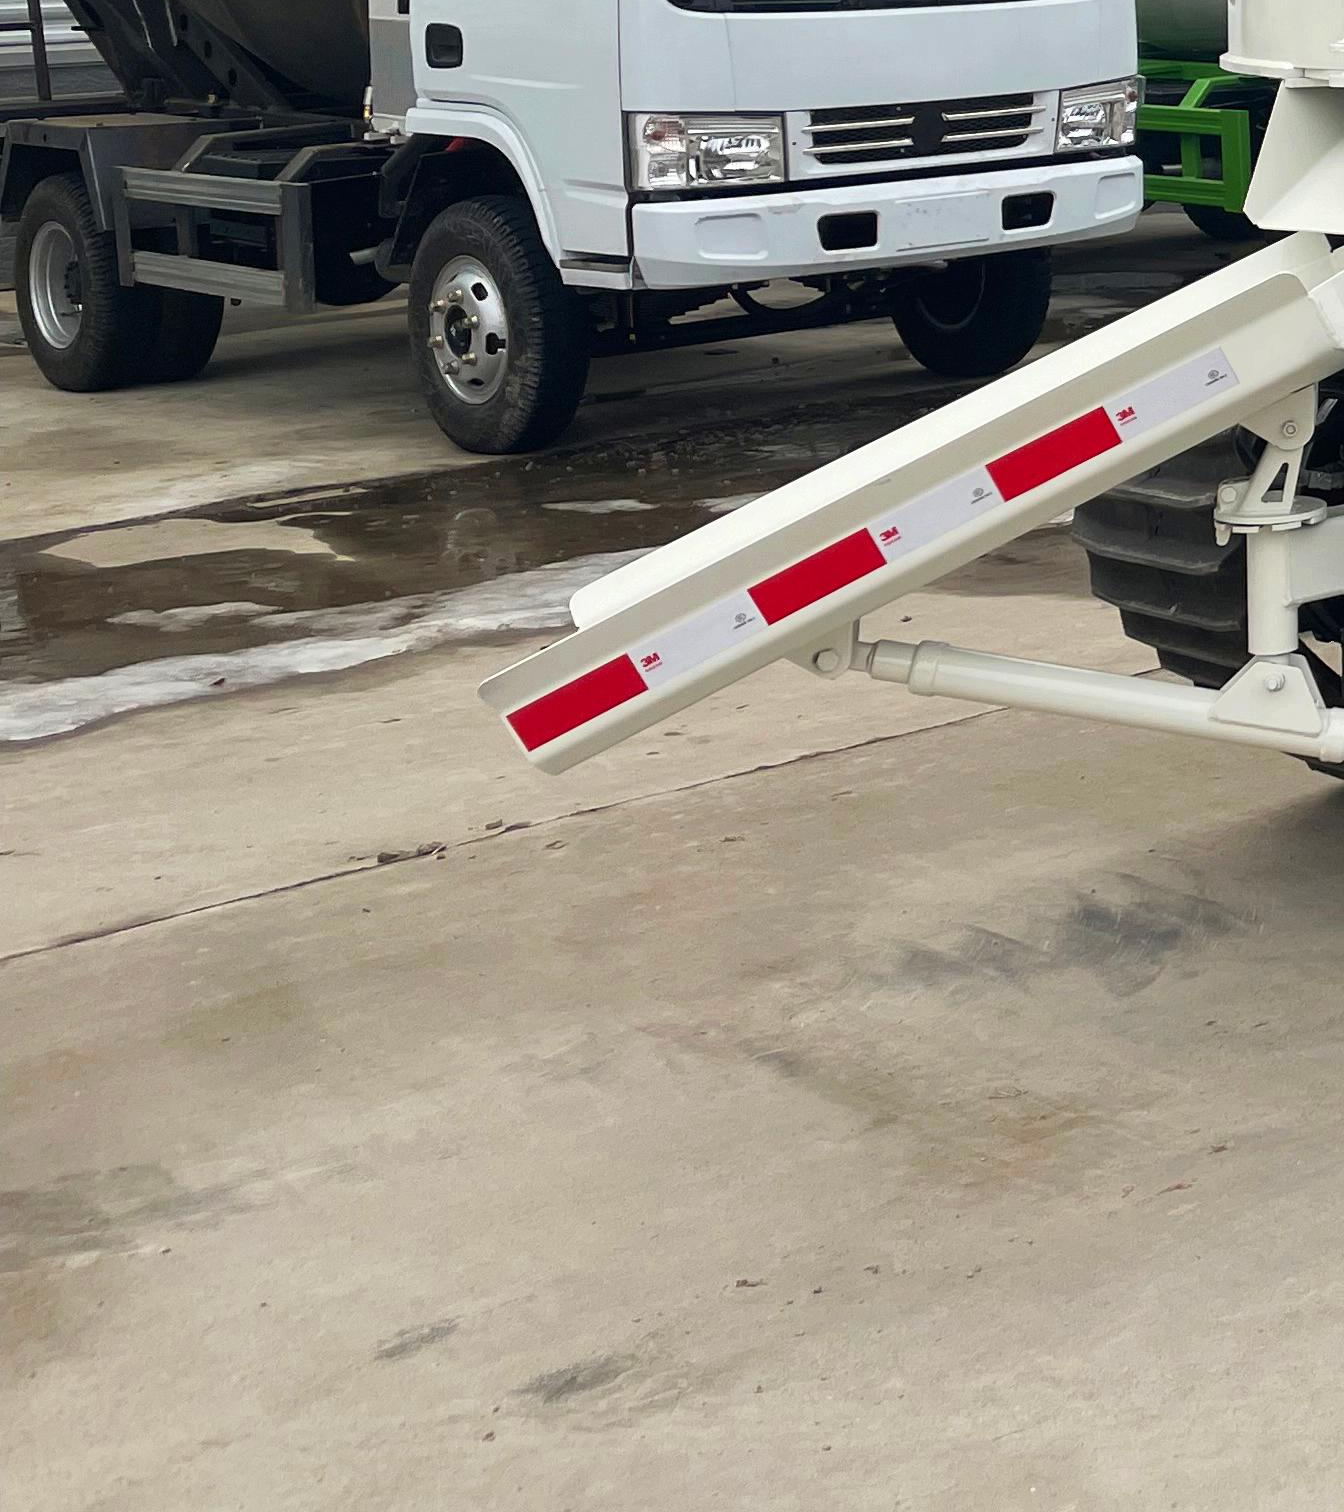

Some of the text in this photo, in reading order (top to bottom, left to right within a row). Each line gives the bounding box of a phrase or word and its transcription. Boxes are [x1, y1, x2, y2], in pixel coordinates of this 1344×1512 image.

[1115, 406, 1136, 422] 3M
[879, 526, 899, 542] 3M
[640, 652, 660, 668] 3M
